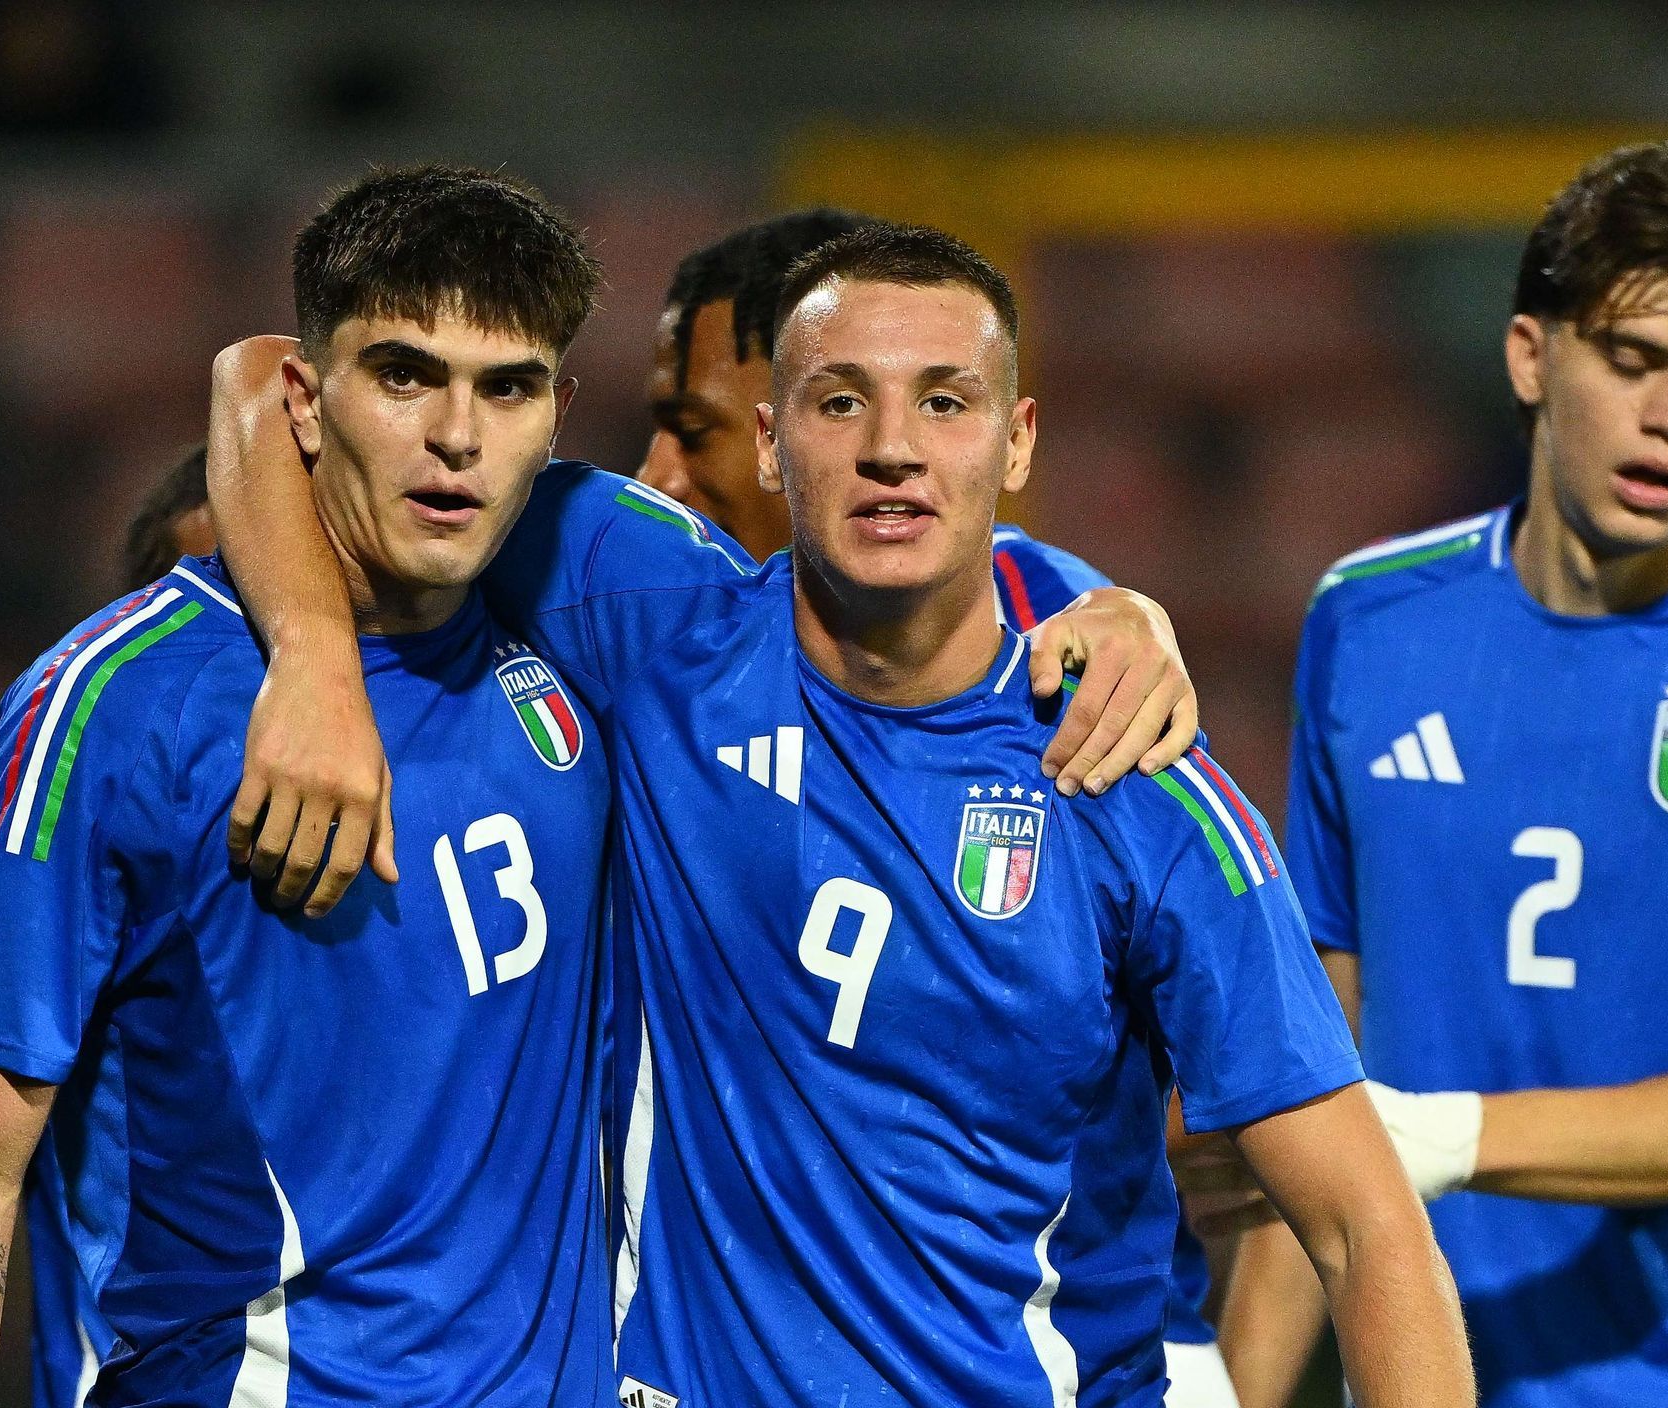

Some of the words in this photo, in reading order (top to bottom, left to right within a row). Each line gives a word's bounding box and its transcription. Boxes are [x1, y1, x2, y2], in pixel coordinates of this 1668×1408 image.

[501, 664, 551, 696] ITALIA
[432, 813, 548, 997] 13
[968, 811, 1035, 838] ITALIA
[798, 876, 894, 1050] 9
[1507, 827, 1584, 989] 2
